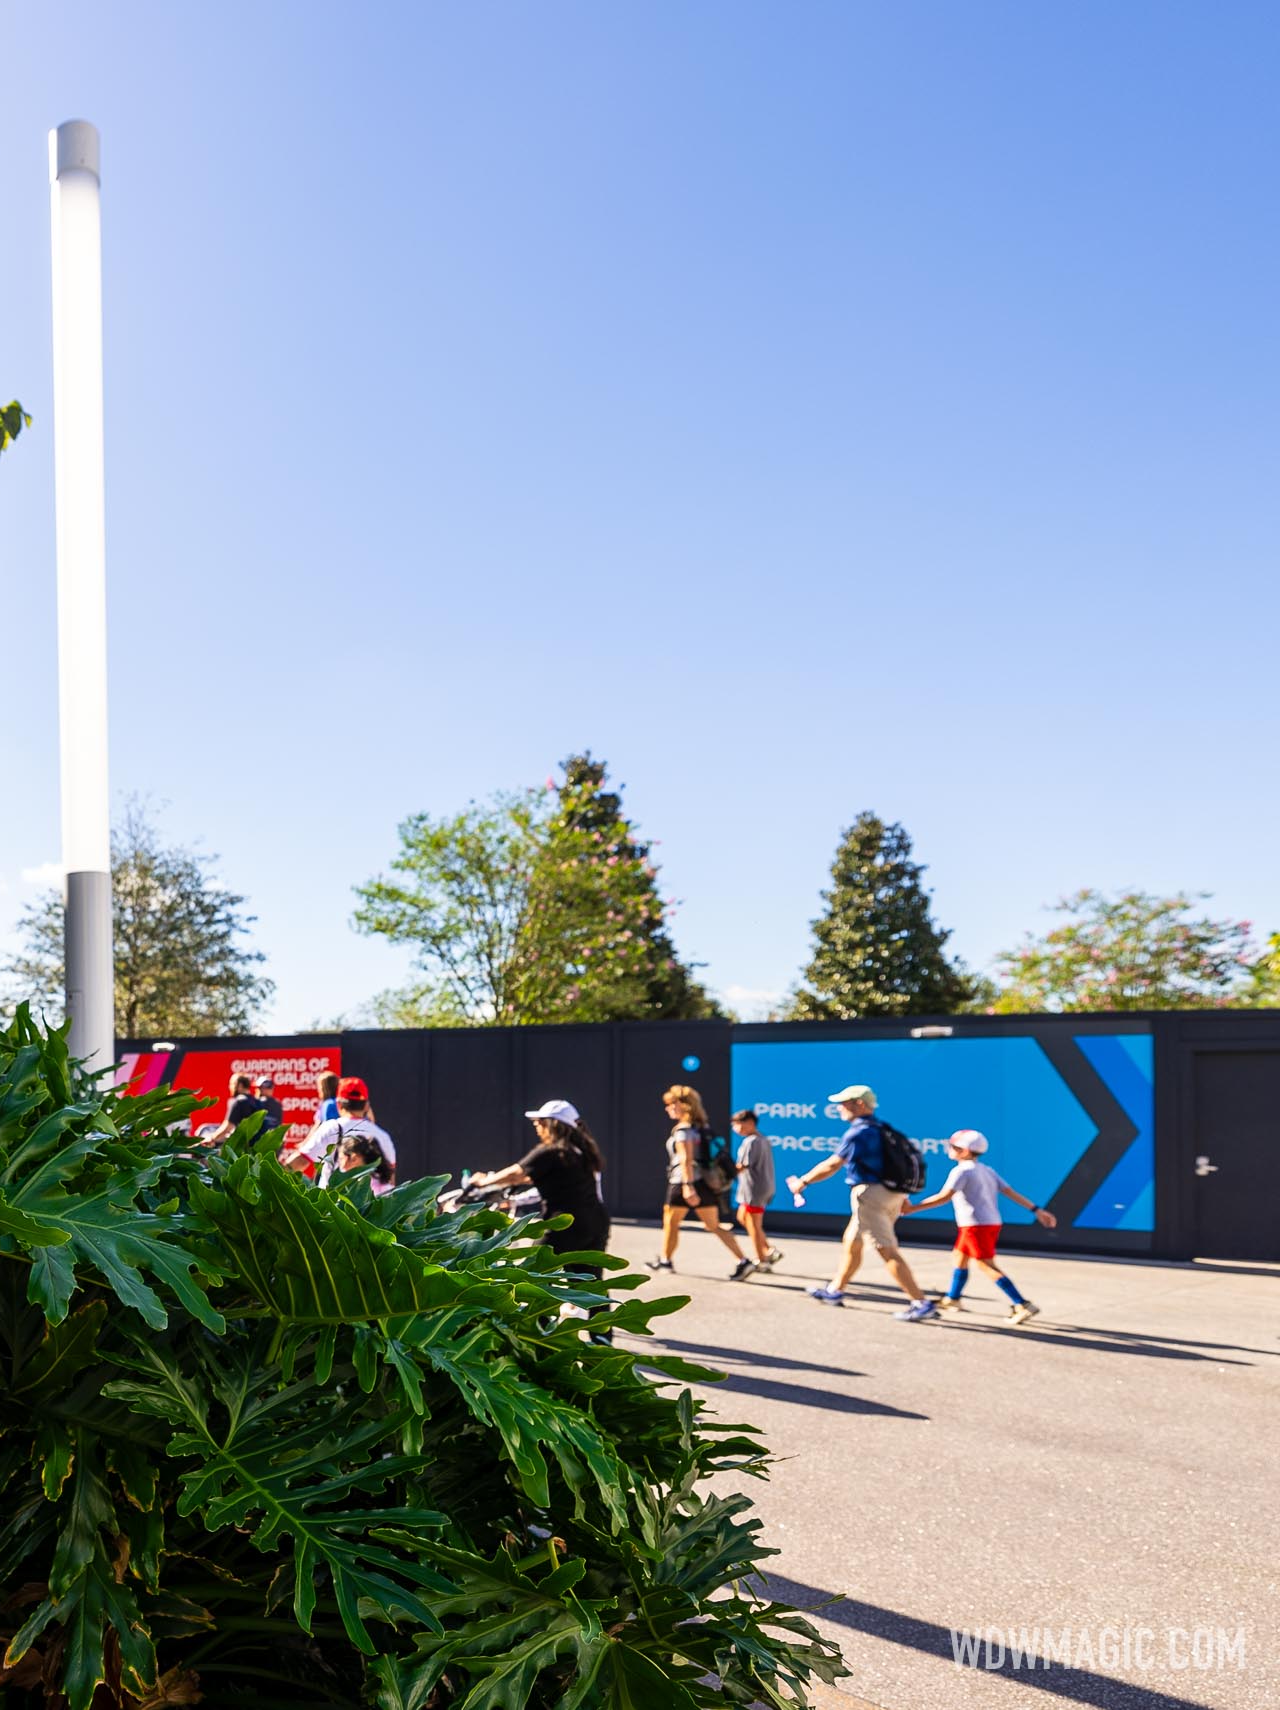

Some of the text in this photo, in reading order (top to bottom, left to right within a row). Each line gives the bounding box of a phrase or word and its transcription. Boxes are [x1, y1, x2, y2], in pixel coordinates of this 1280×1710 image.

[231, 1057, 330, 1073] GUARDIANS OF
[281, 1096, 320, 1111] SPAC
[754, 1103, 817, 1119] PARK
